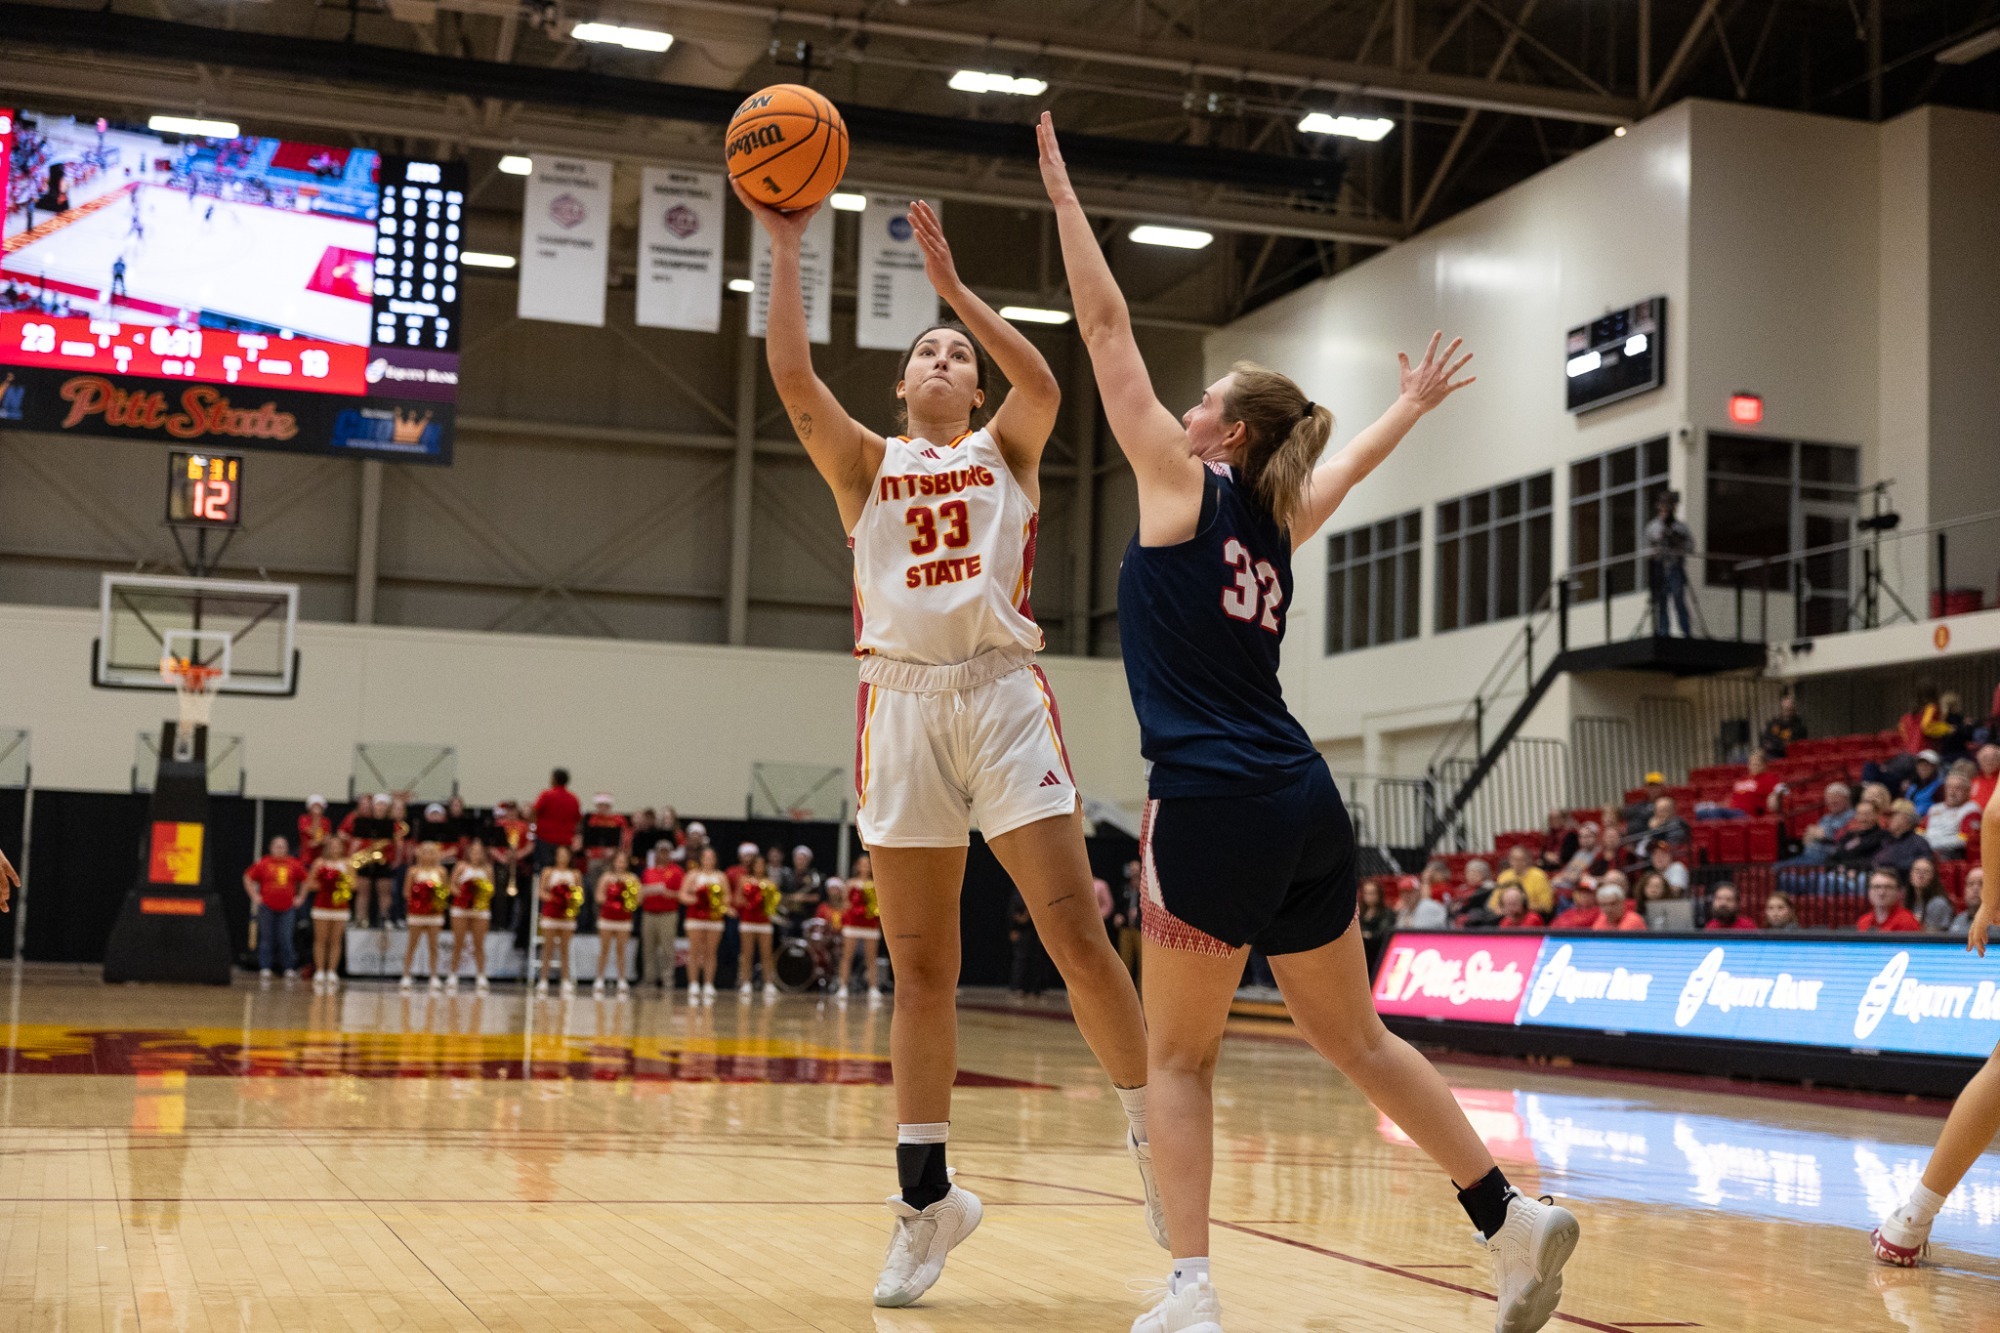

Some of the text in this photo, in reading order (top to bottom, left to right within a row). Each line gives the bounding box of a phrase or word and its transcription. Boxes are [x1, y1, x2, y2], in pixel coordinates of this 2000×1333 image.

[60, 375, 168, 429] Pitt
[165, 385, 298, 441] State
[193, 480, 231, 521] 12
[875, 464, 995, 506] ITTSBURG
[905, 499, 971, 557] 33
[905, 553, 982, 590] STATE
[1221, 536, 1284, 636] 32
